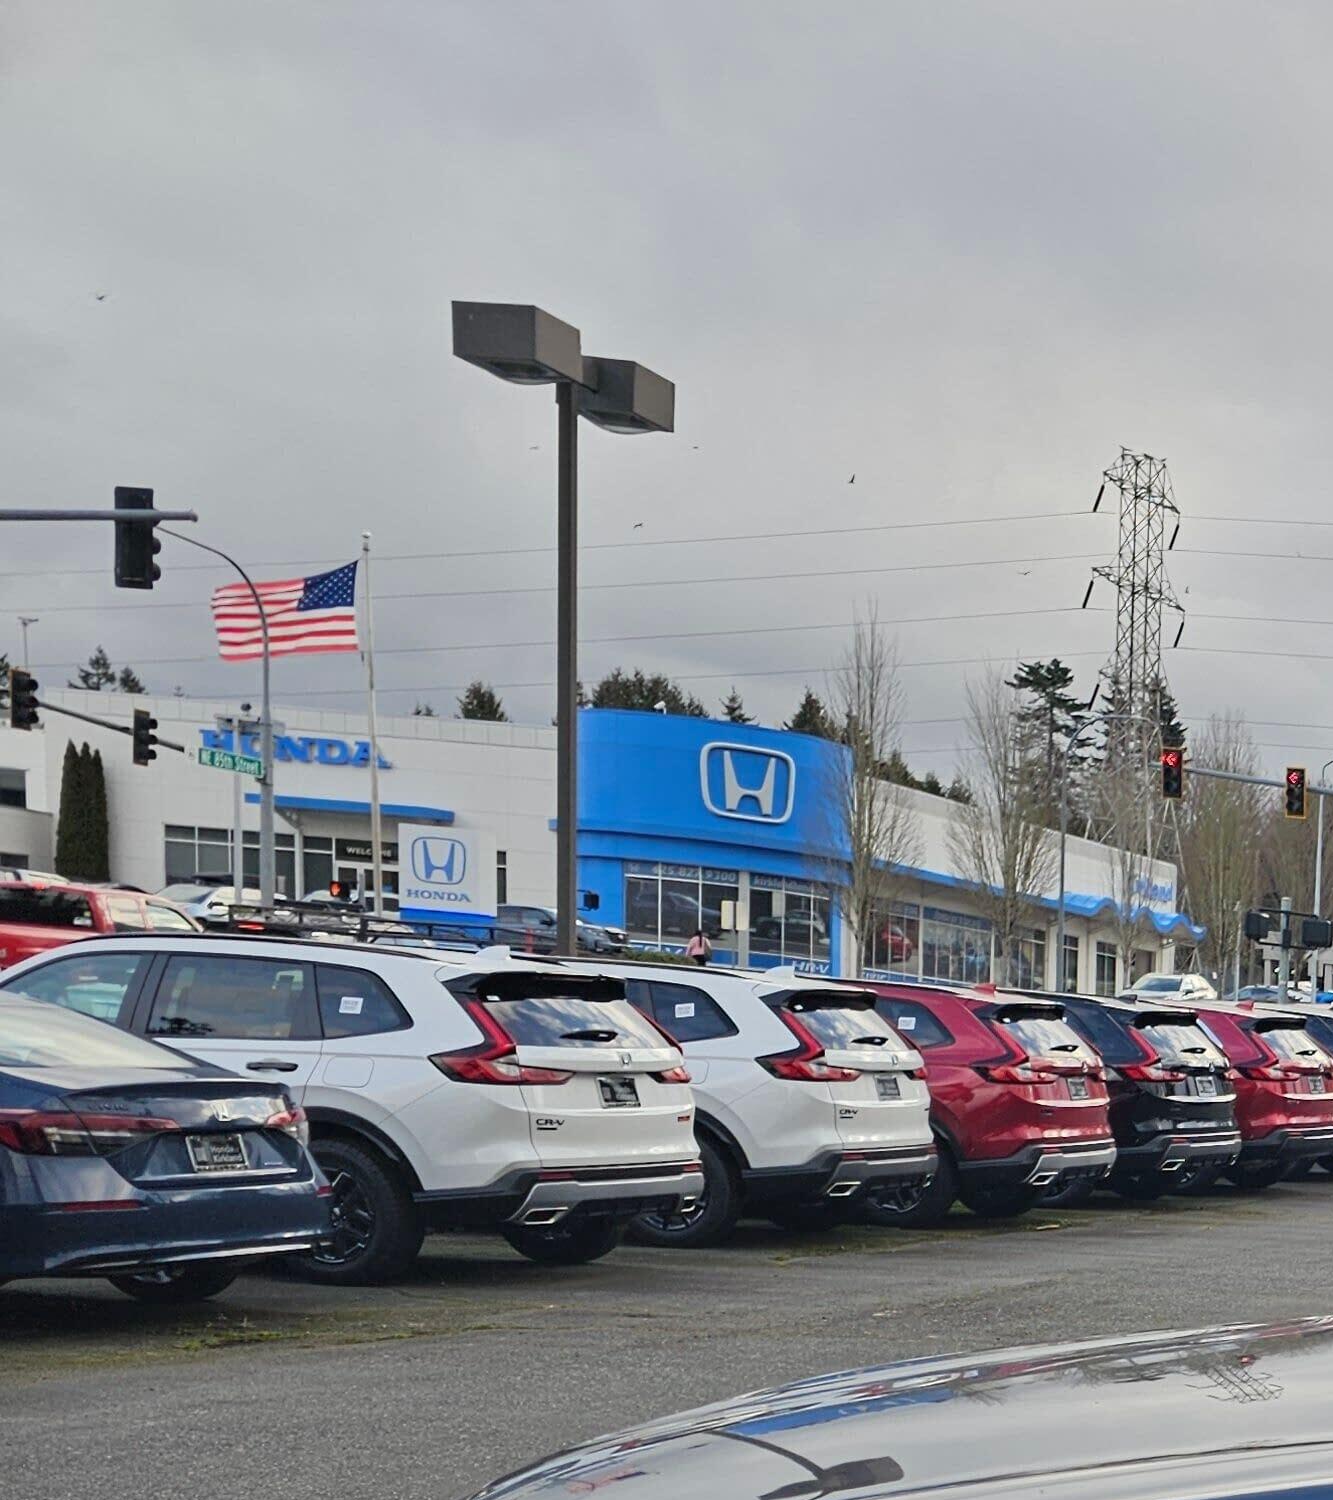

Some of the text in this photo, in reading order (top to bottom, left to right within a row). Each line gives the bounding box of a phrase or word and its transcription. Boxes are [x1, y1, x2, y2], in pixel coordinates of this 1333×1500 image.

[198, 729, 393, 769] HONDA
[201, 749, 213, 765] NE
[235, 756, 259, 776] Street
[346, 846, 393, 858] WELCME
[405, 887, 472, 903] HONDA
[535, 1117, 566, 1127] CR-V
